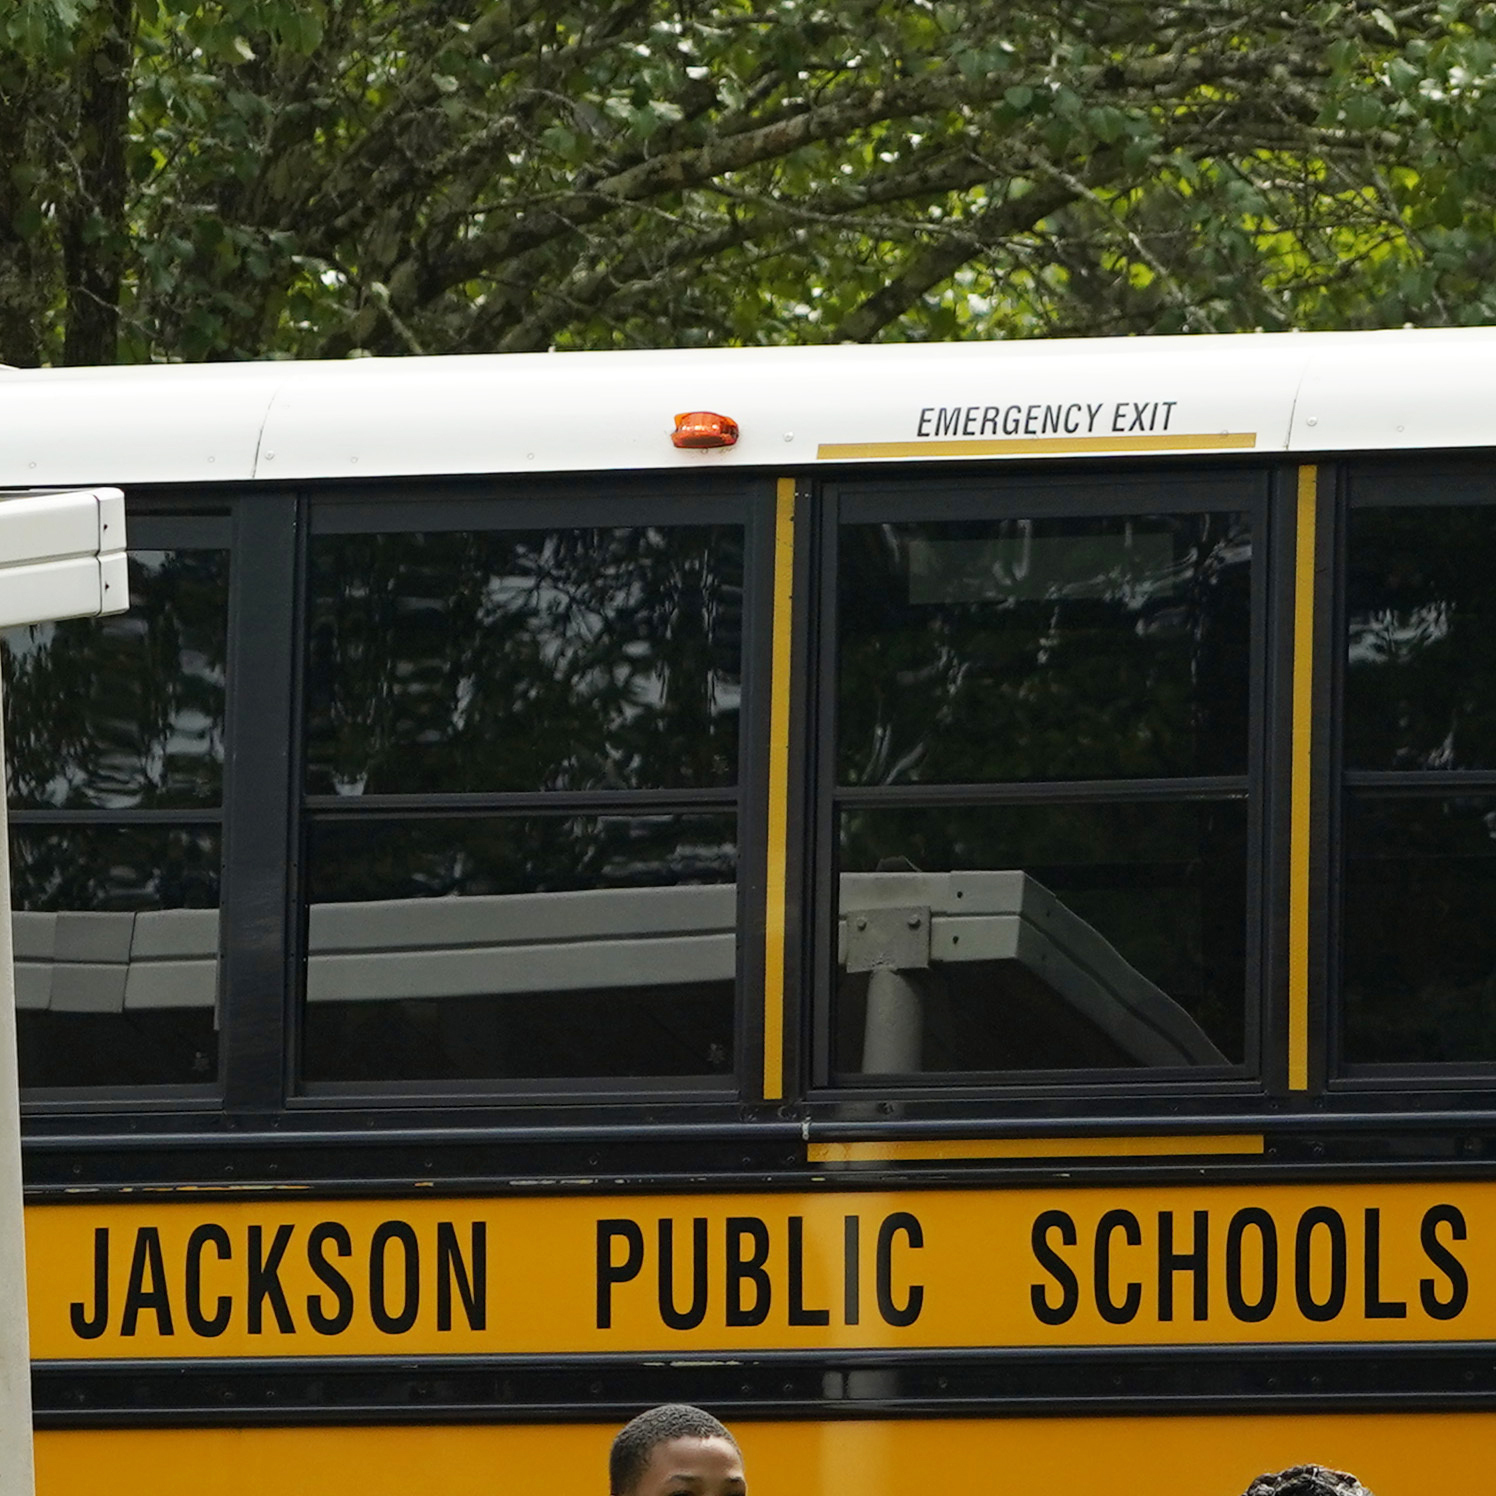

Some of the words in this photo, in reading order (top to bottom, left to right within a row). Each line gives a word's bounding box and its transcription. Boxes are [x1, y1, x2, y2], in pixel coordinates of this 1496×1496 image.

[917, 404, 1103, 437] EMERGENCY
[1112, 402, 1177, 432] EXIT
[70, 1220, 487, 1339] JACKSON
[596, 1211, 924, 1331] PUBLIC
[1030, 1204, 1469, 1325] SCHOOLS
